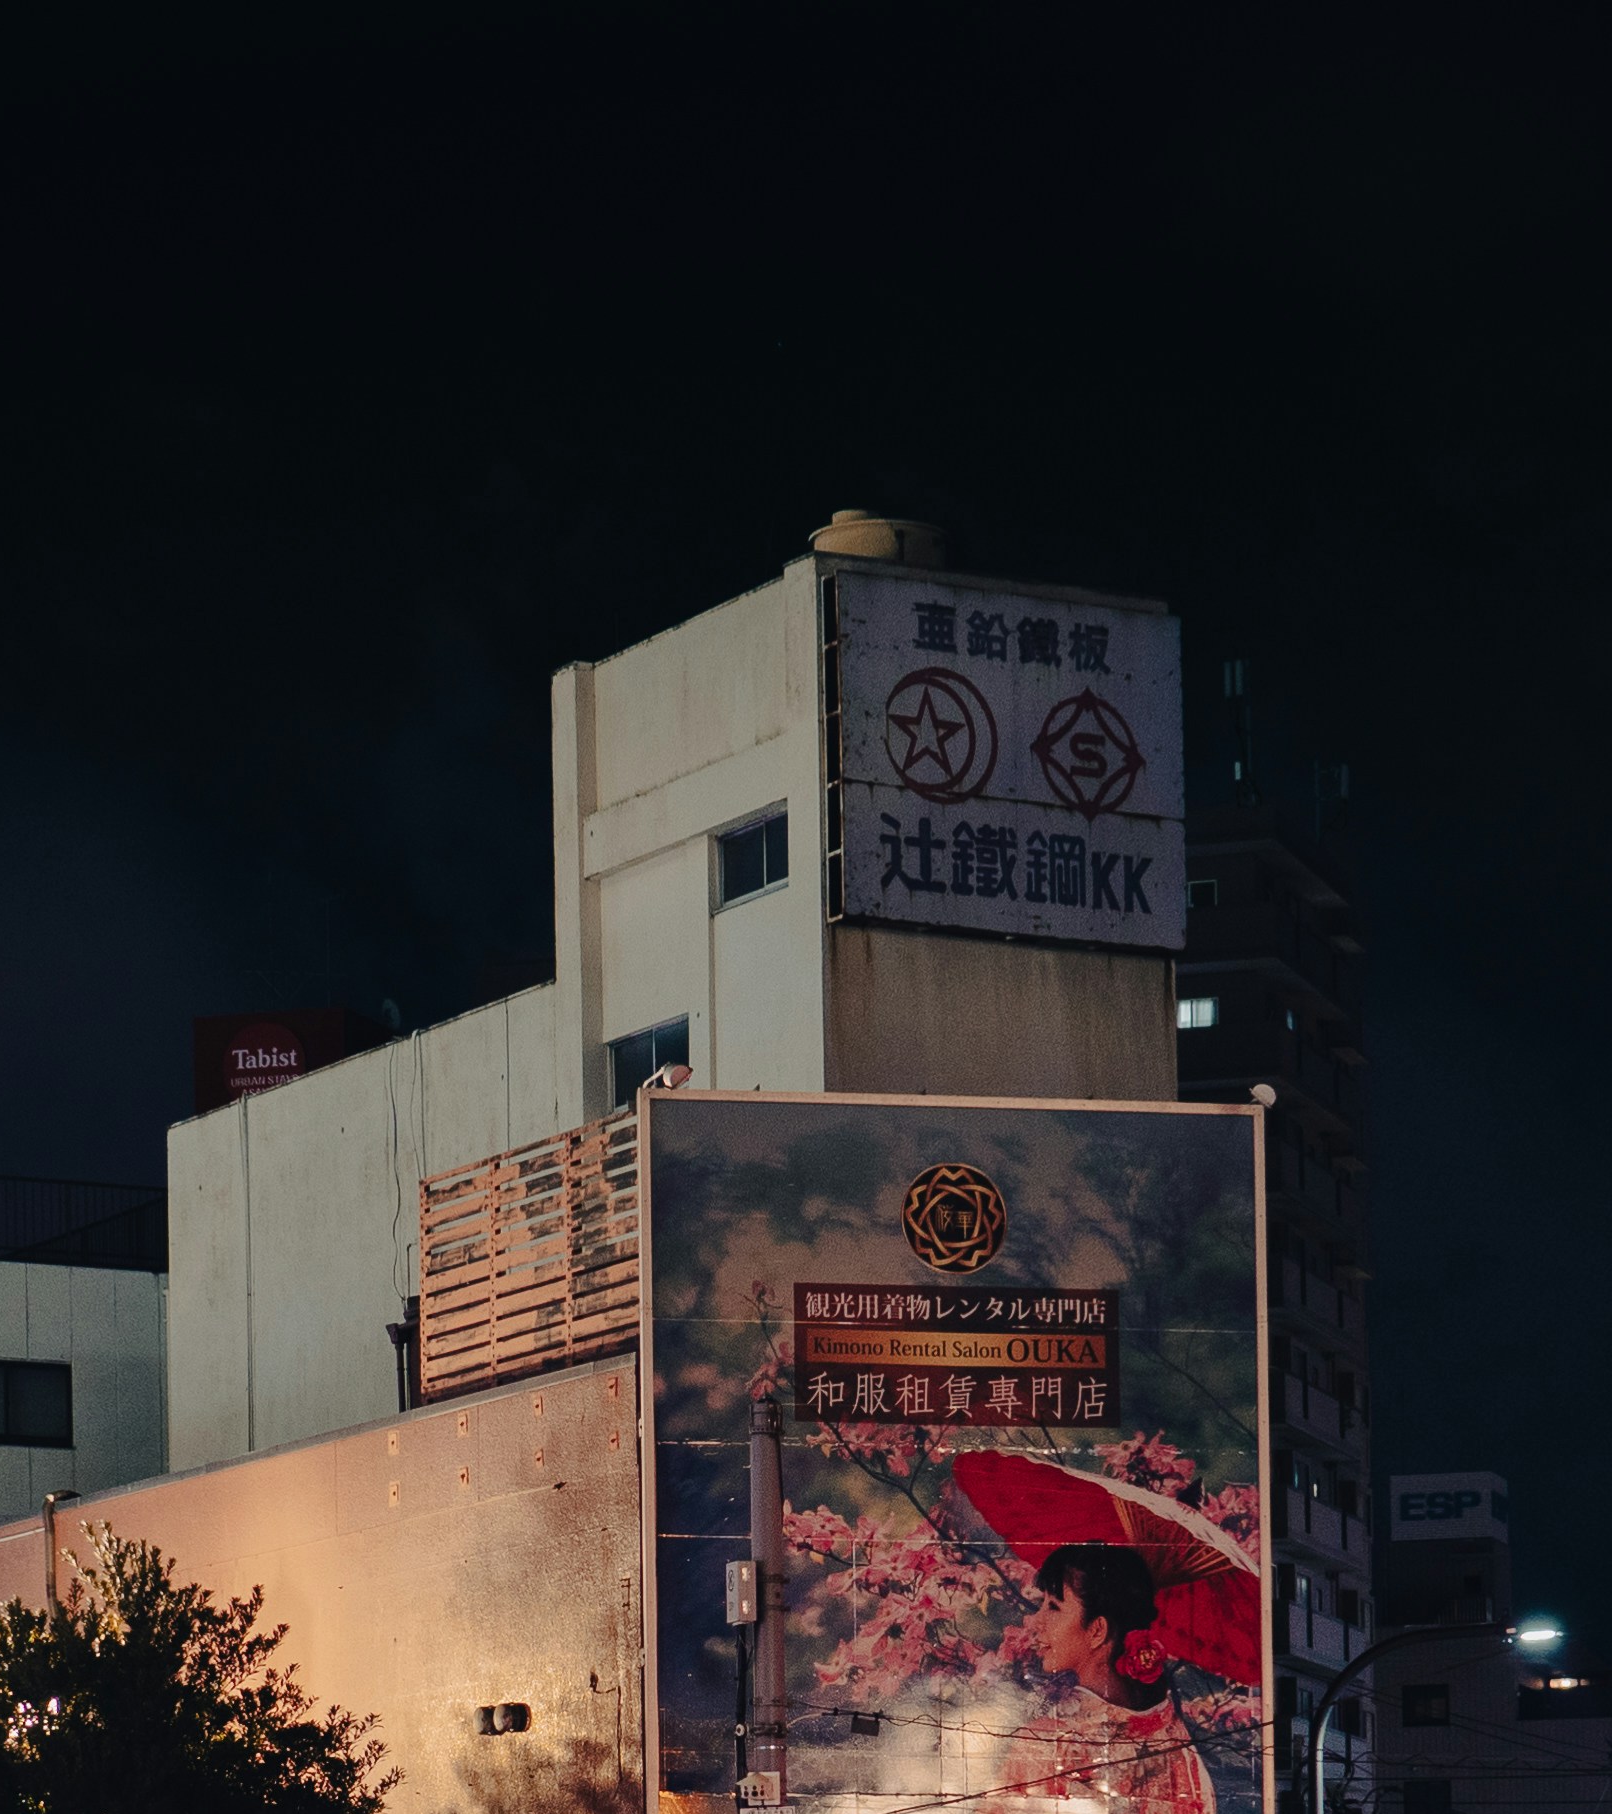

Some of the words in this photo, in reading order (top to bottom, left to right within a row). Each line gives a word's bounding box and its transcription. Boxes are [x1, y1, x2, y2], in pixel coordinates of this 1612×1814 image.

[231, 1046, 298, 1070] Tabist
[805, 1291, 1107, 1325] 観光用着物レンタル専門店
[813, 1336, 885, 1357] Kimono
[889, 1338, 947, 1359] Rental
[952, 1340, 1002, 1360] Salon
[1006, 1338, 1100, 1364] OUKA
[806, 1371, 1108, 1421] 和服租賃專門店
[1400, 1491, 1481, 1521] ESP
